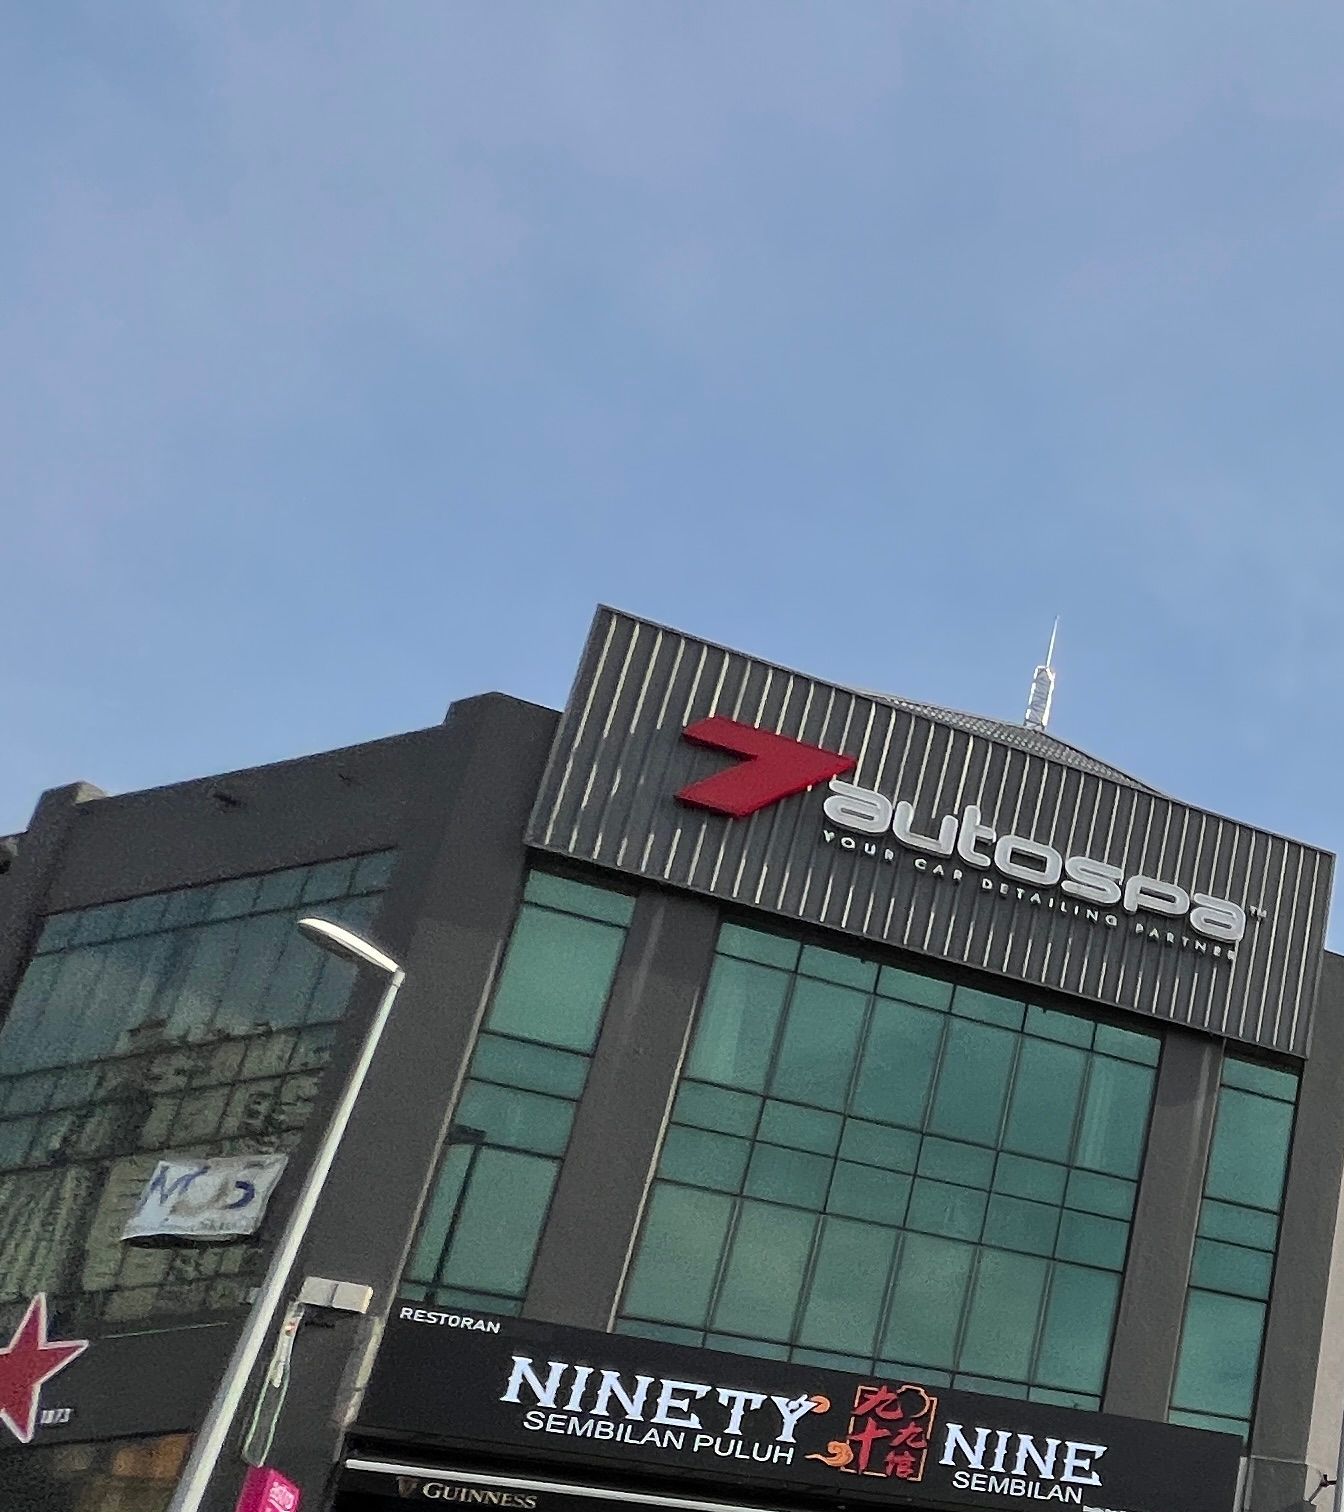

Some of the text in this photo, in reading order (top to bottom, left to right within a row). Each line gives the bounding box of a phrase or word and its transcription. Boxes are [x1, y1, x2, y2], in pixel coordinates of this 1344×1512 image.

[823, 780, 1246, 944] autospa
[823, 829, 1237, 961] YOUR CAR DETAILING PARTNER
[400, 1306, 501, 1335] RESTORAN
[499, 1354, 818, 1444] NINETY
[523, 1409, 796, 1466] SEMBILAN PULUH
[938, 1421, 1108, 1488] NINE
[422, 1481, 538, 1511] GUINNESS
[951, 1470, 1085, 1505] SEMBILAN
